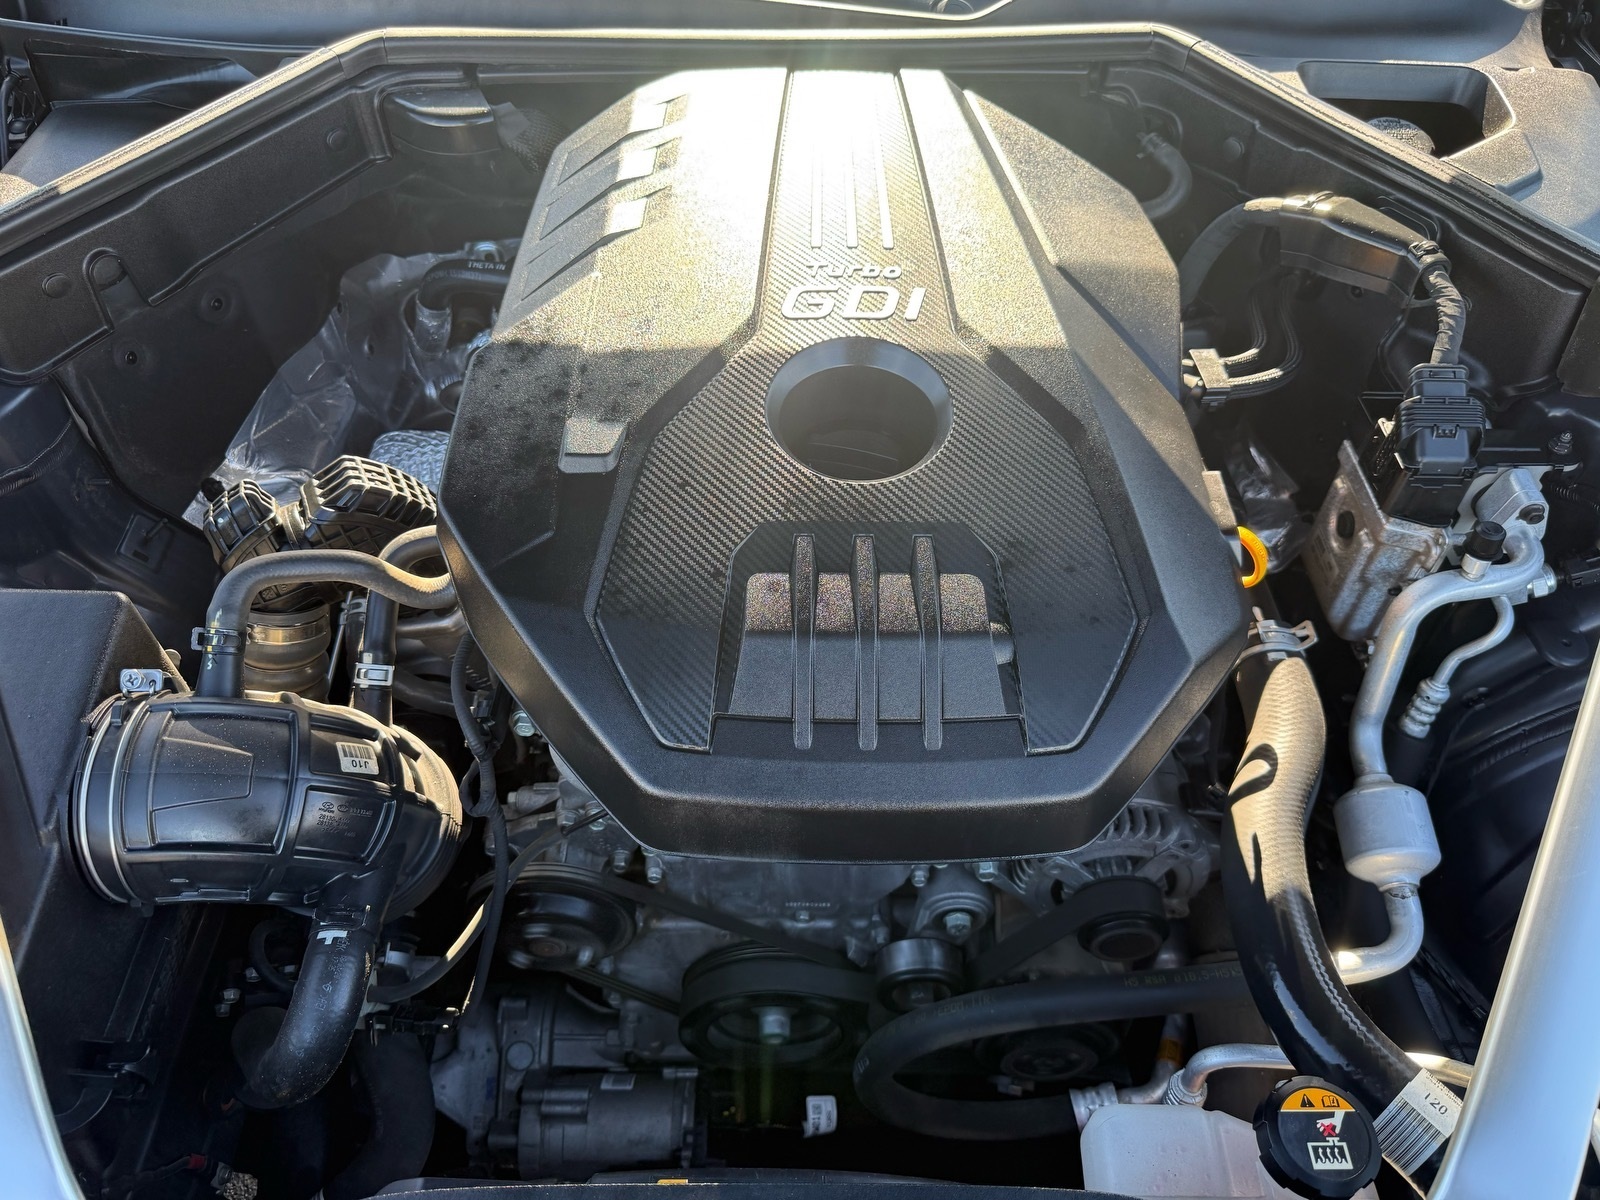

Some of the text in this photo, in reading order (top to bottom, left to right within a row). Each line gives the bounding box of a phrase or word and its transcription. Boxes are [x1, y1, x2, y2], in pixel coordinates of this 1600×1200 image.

[468, 261, 506, 271] THETA IN
[806, 262, 903, 280] Turbo
[781, 284, 927, 322] GDI
[351, 759, 370, 769] J10
